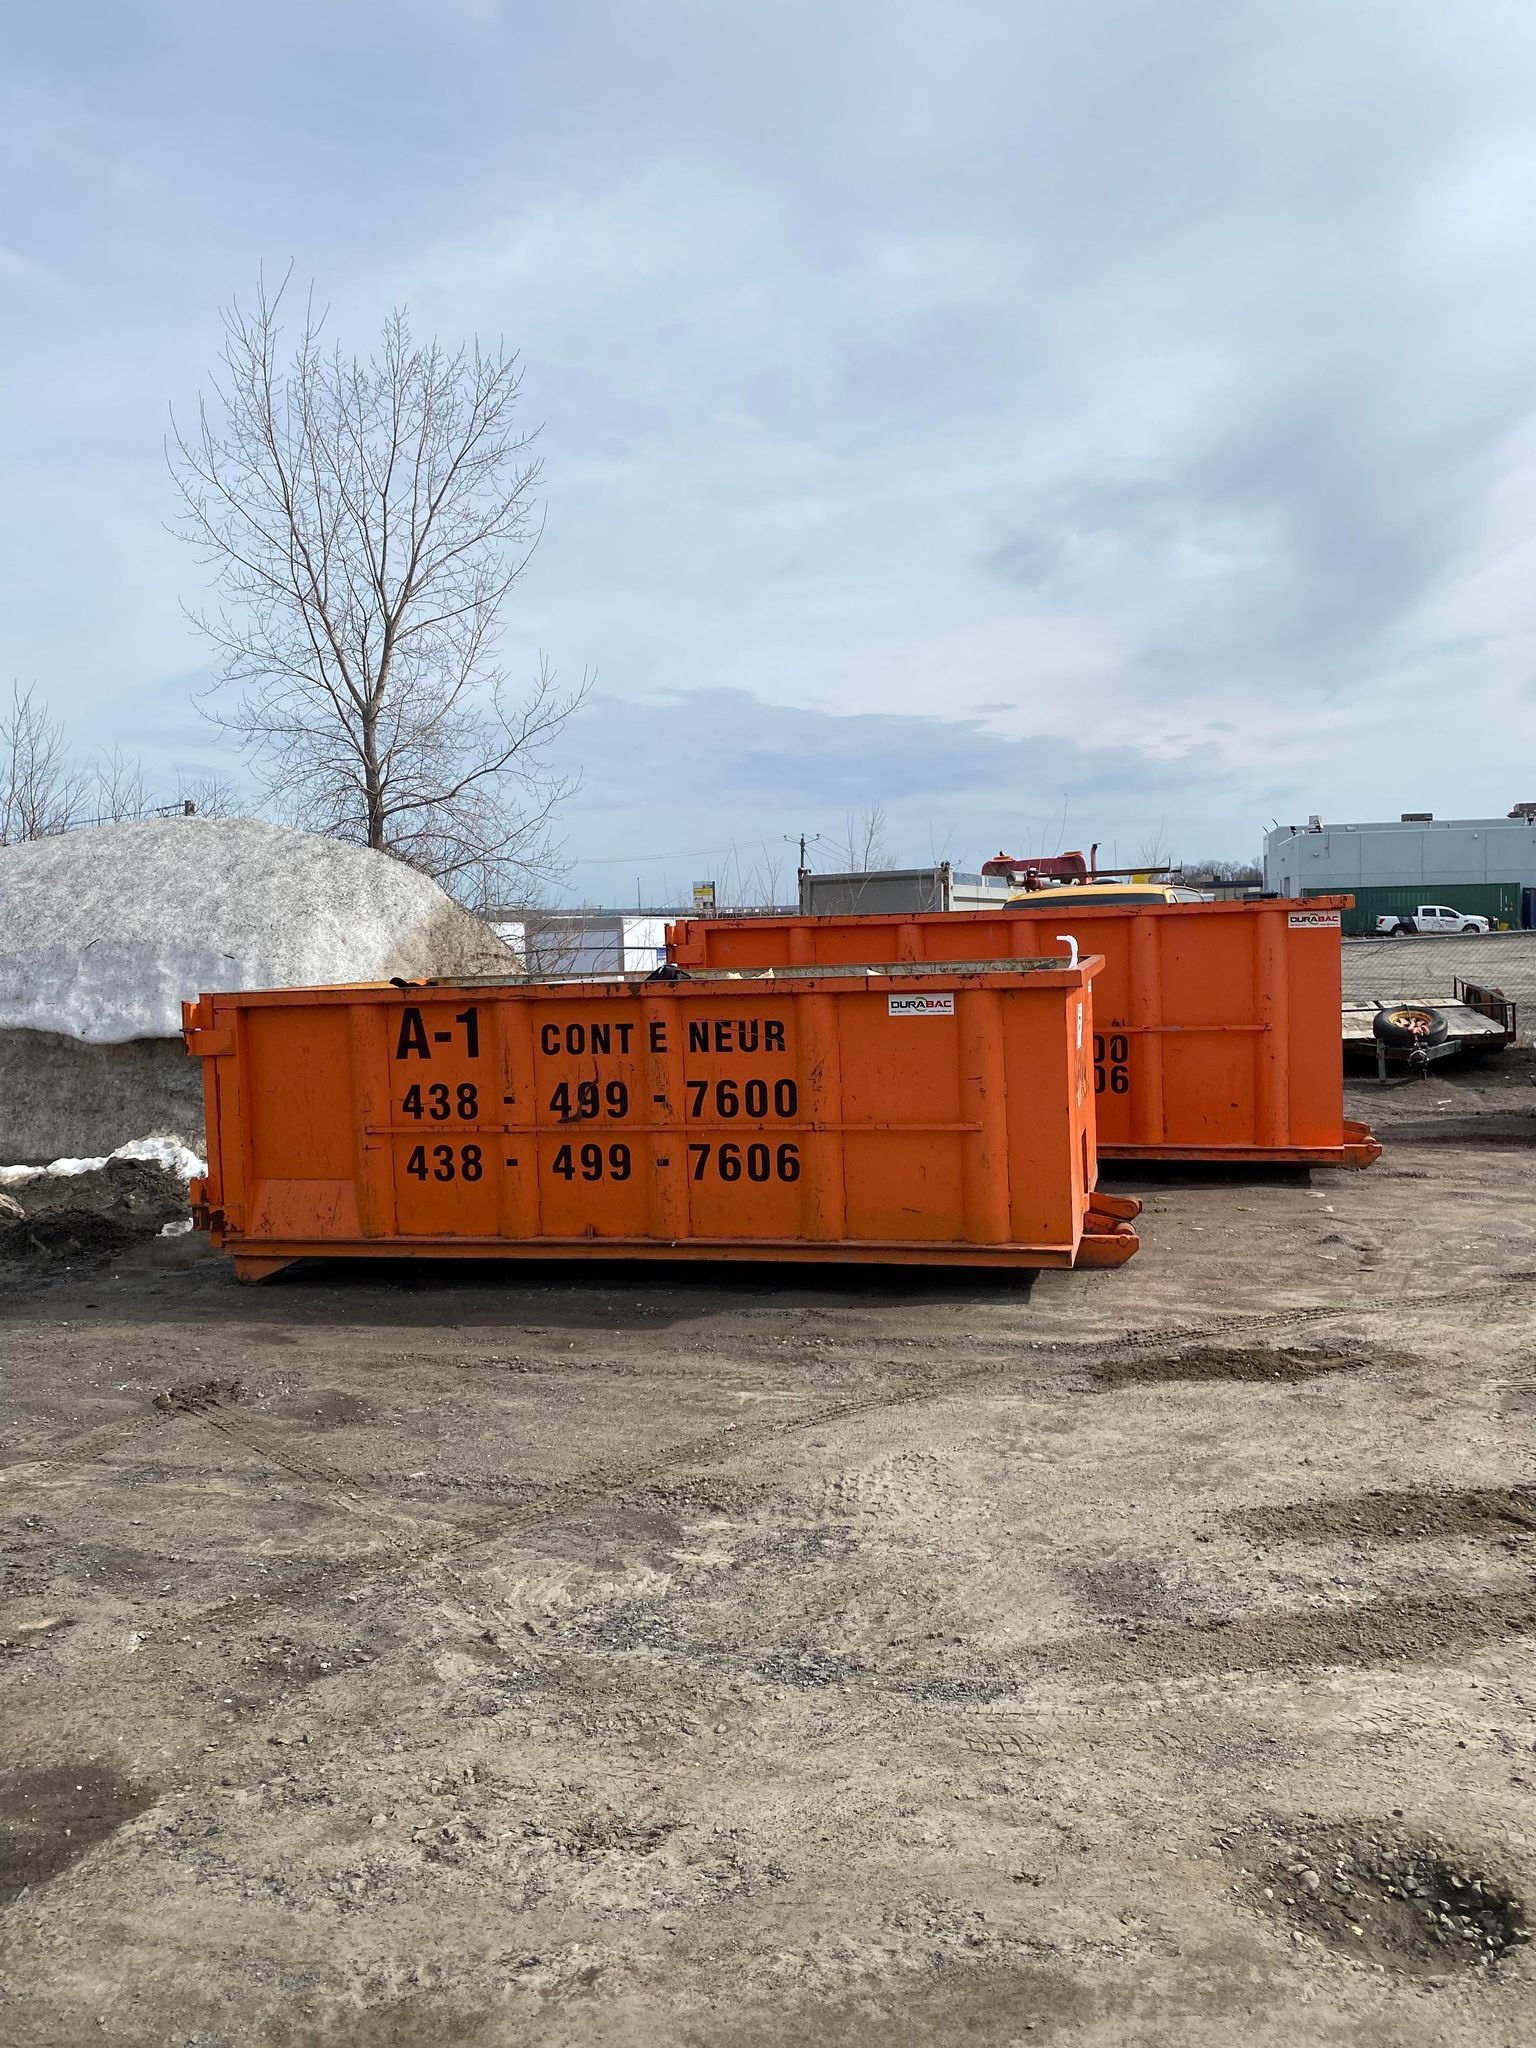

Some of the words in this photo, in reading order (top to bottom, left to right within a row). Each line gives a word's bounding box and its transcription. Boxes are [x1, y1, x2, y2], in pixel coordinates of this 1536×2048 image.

[1290, 915, 1339, 923] DURABAC
[891, 1000, 952, 1009] DURABAC
[395, 1007, 479, 1060] A-1
